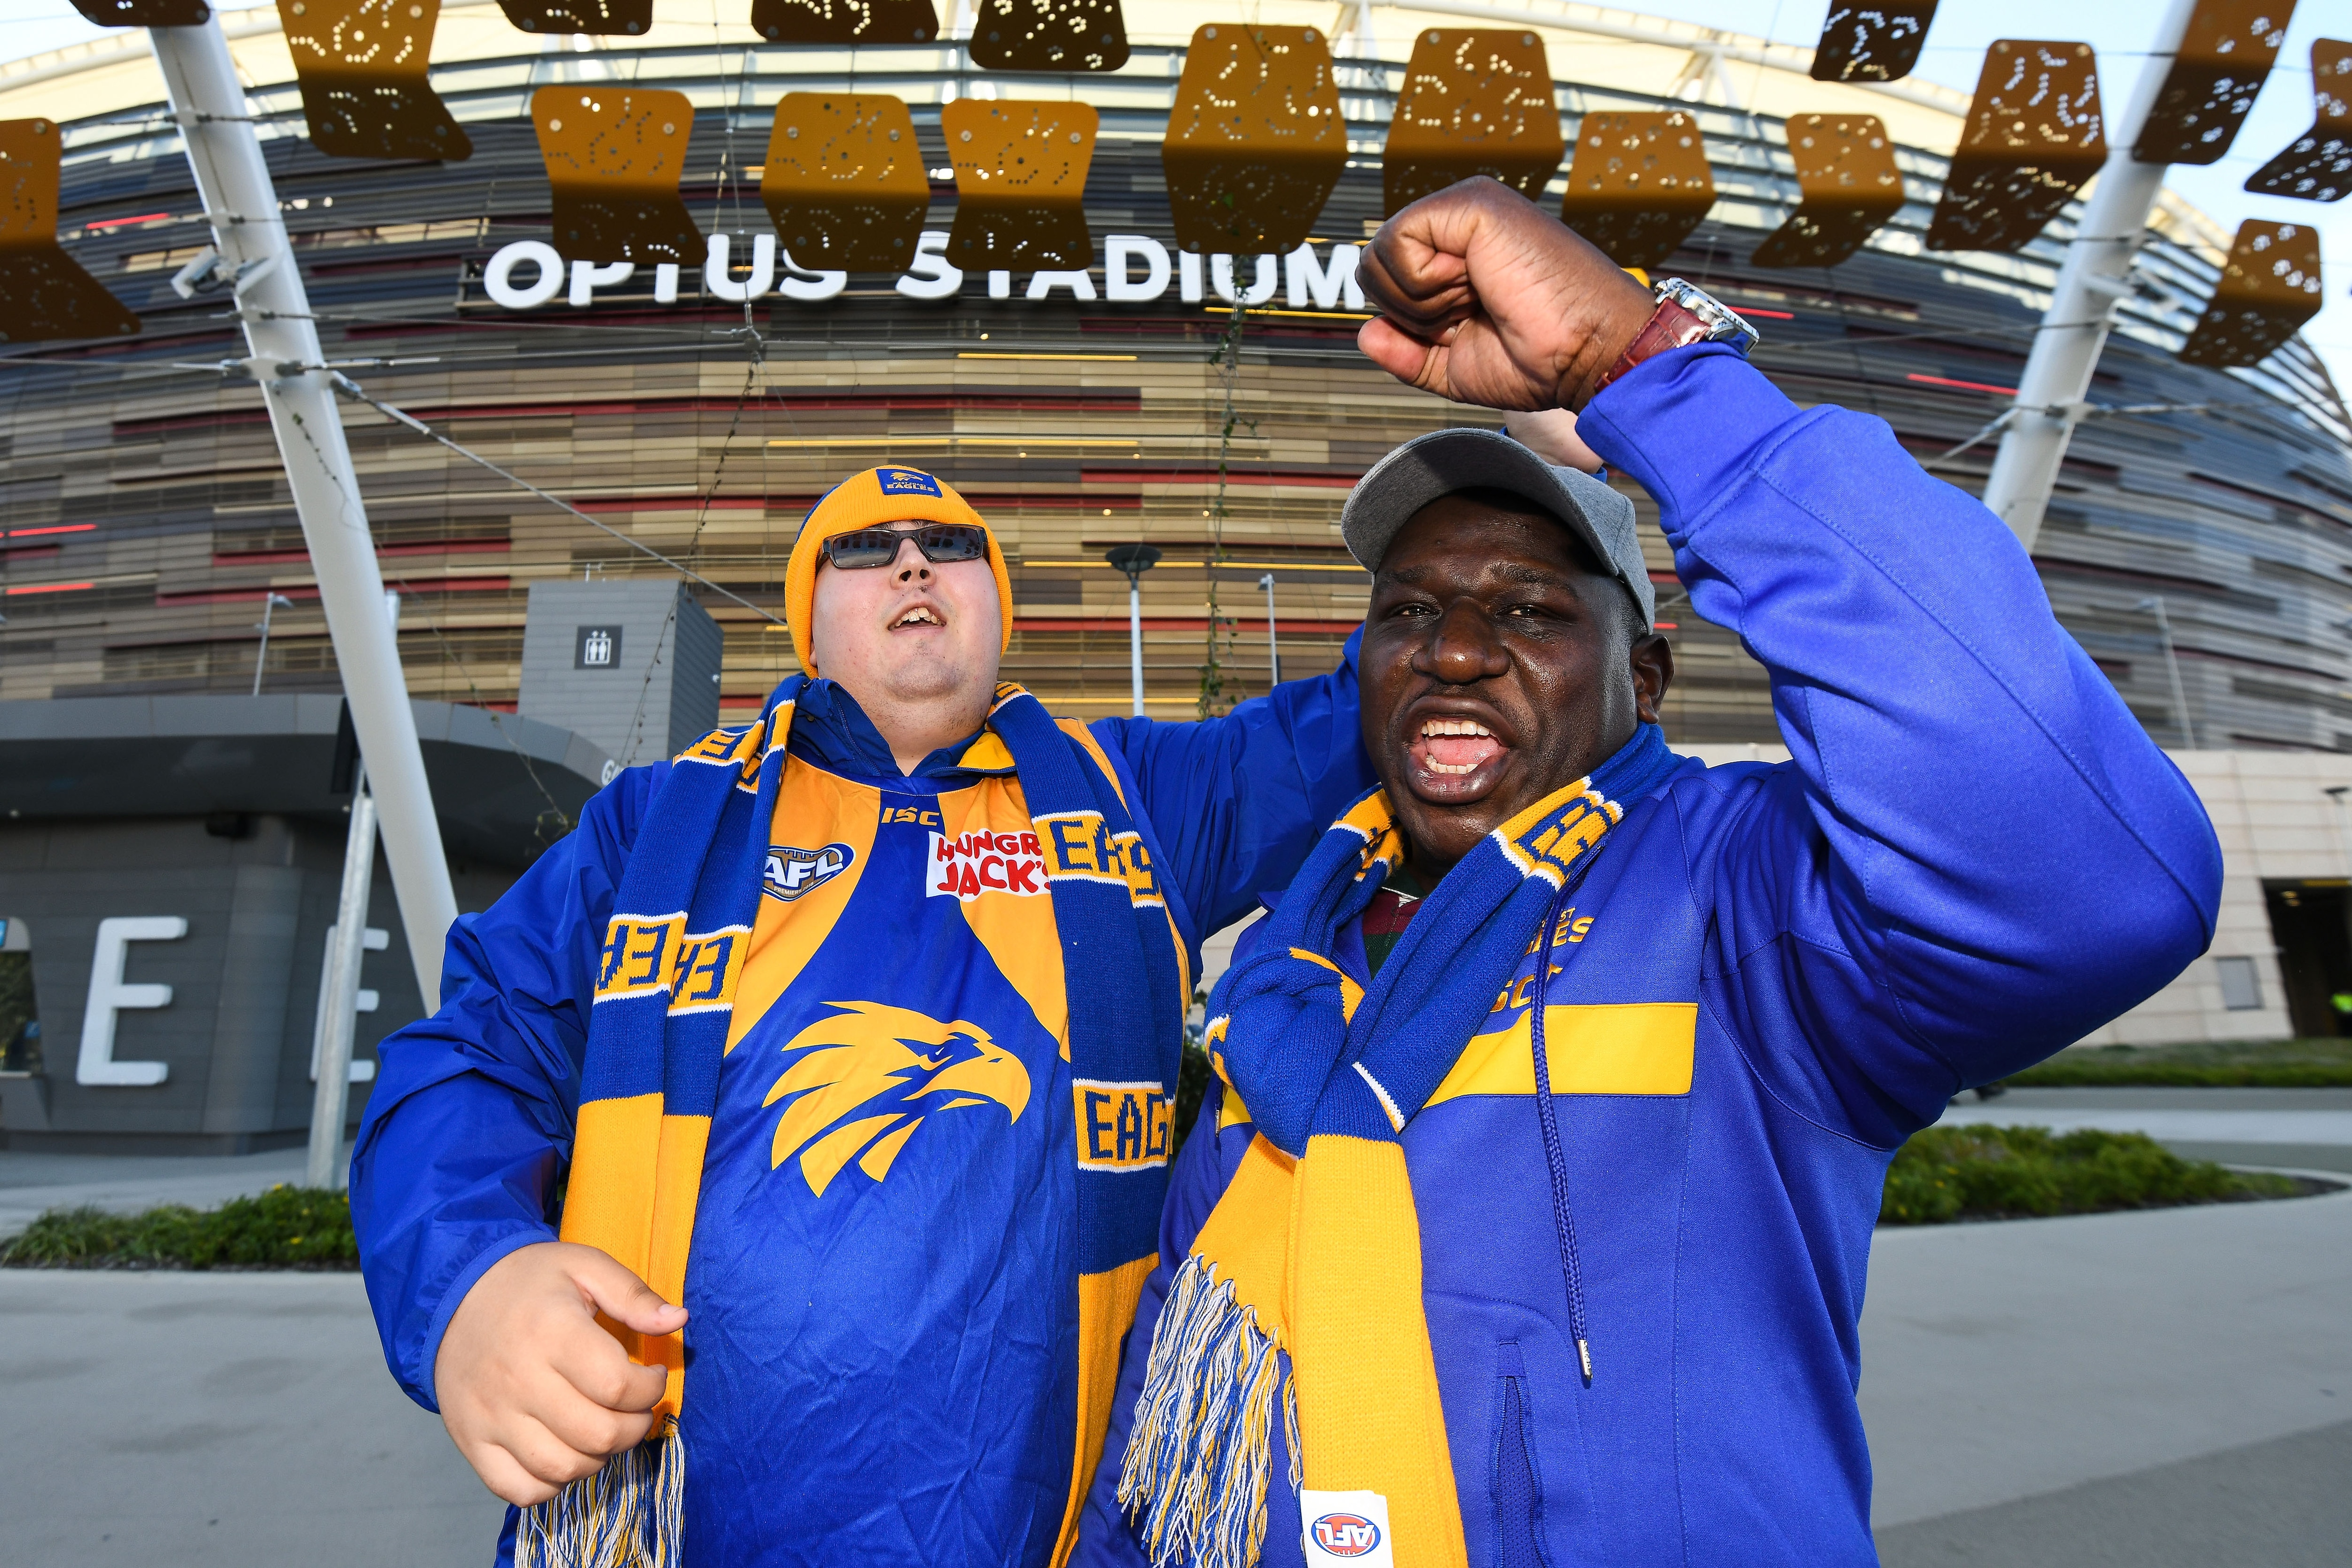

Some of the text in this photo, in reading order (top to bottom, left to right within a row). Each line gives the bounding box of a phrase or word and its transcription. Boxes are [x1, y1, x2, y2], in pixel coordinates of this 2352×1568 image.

[887, 483, 935, 492] EAGLES
[881, 807, 940, 826] ISC
[763, 850, 844, 888] AFL
[773, 886, 802, 895] PREMIERS
[76, 916, 189, 1085] E
[1315, 1522, 1375, 1547] AFL
